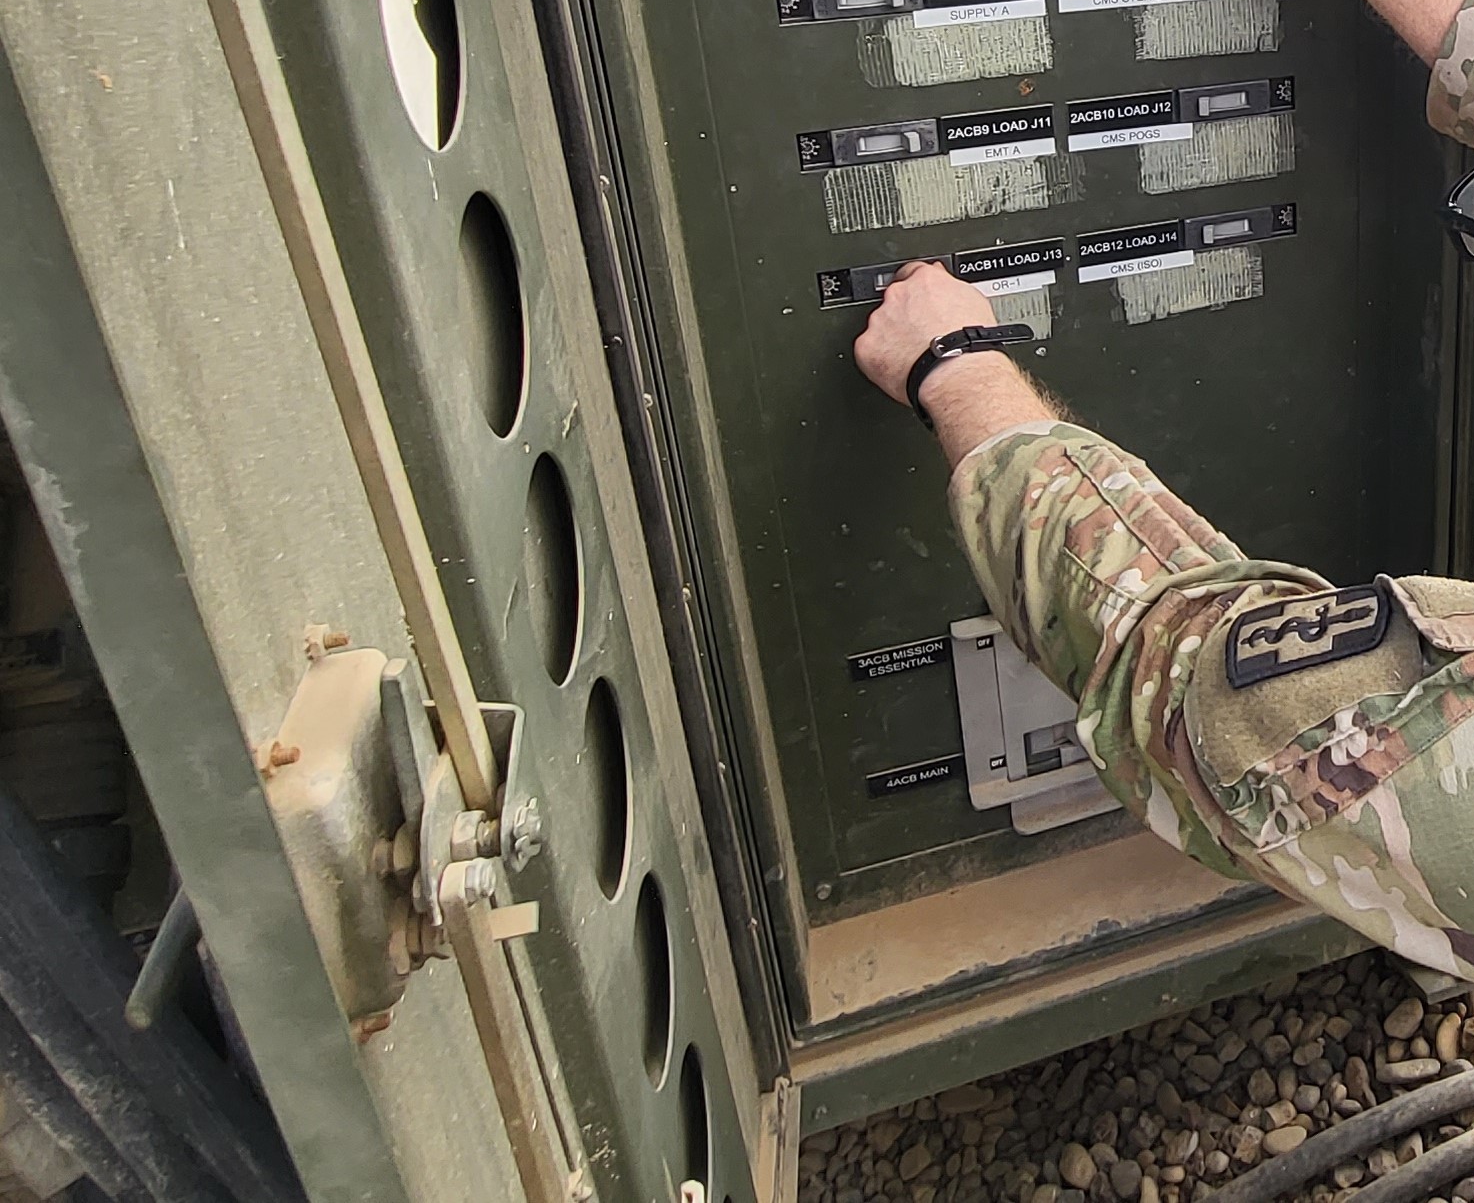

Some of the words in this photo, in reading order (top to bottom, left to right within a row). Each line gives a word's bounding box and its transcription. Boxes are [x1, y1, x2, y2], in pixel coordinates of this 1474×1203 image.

[950, 7, 998, 21] SUPPLY
[1001, 6, 1010, 16] A
[1070, 109, 1115, 124] 2ACB10
[1118, 105, 1150, 117] LOAD
[1152, 102, 1172, 113] J12
[947, 125, 990, 139] 2ACB9
[993, 121, 1028, 133] LOAD
[1030, 117, 1051, 129] J11
[1101, 133, 1127, 144] CMS
[1129, 129, 1160, 139] POGS
[985, 148, 1008, 159] EMT
[1012, 147, 1021, 155] A
[1080, 242, 1123, 256] 2ACB12
[1126, 236, 1156, 249] LOAD
[1159, 233, 1178, 243] J14
[959, 259, 1004, 274] 2ACB11
[1008, 253, 1040, 267] LOAD
[1042, 249, 1062, 261] J13
[1110, 264, 1134, 274] CMS
[1138, 259, 1162, 271] (ISO)
[992, 279, 1020, 291] OR-1
[857, 653, 890, 669] 3ACB
[892, 641, 944, 661] MISSION
[868, 654, 936, 677] ESSENTIAL
[886, 772, 918, 789] 4ACB
[920, 765, 950, 782] MAIN
